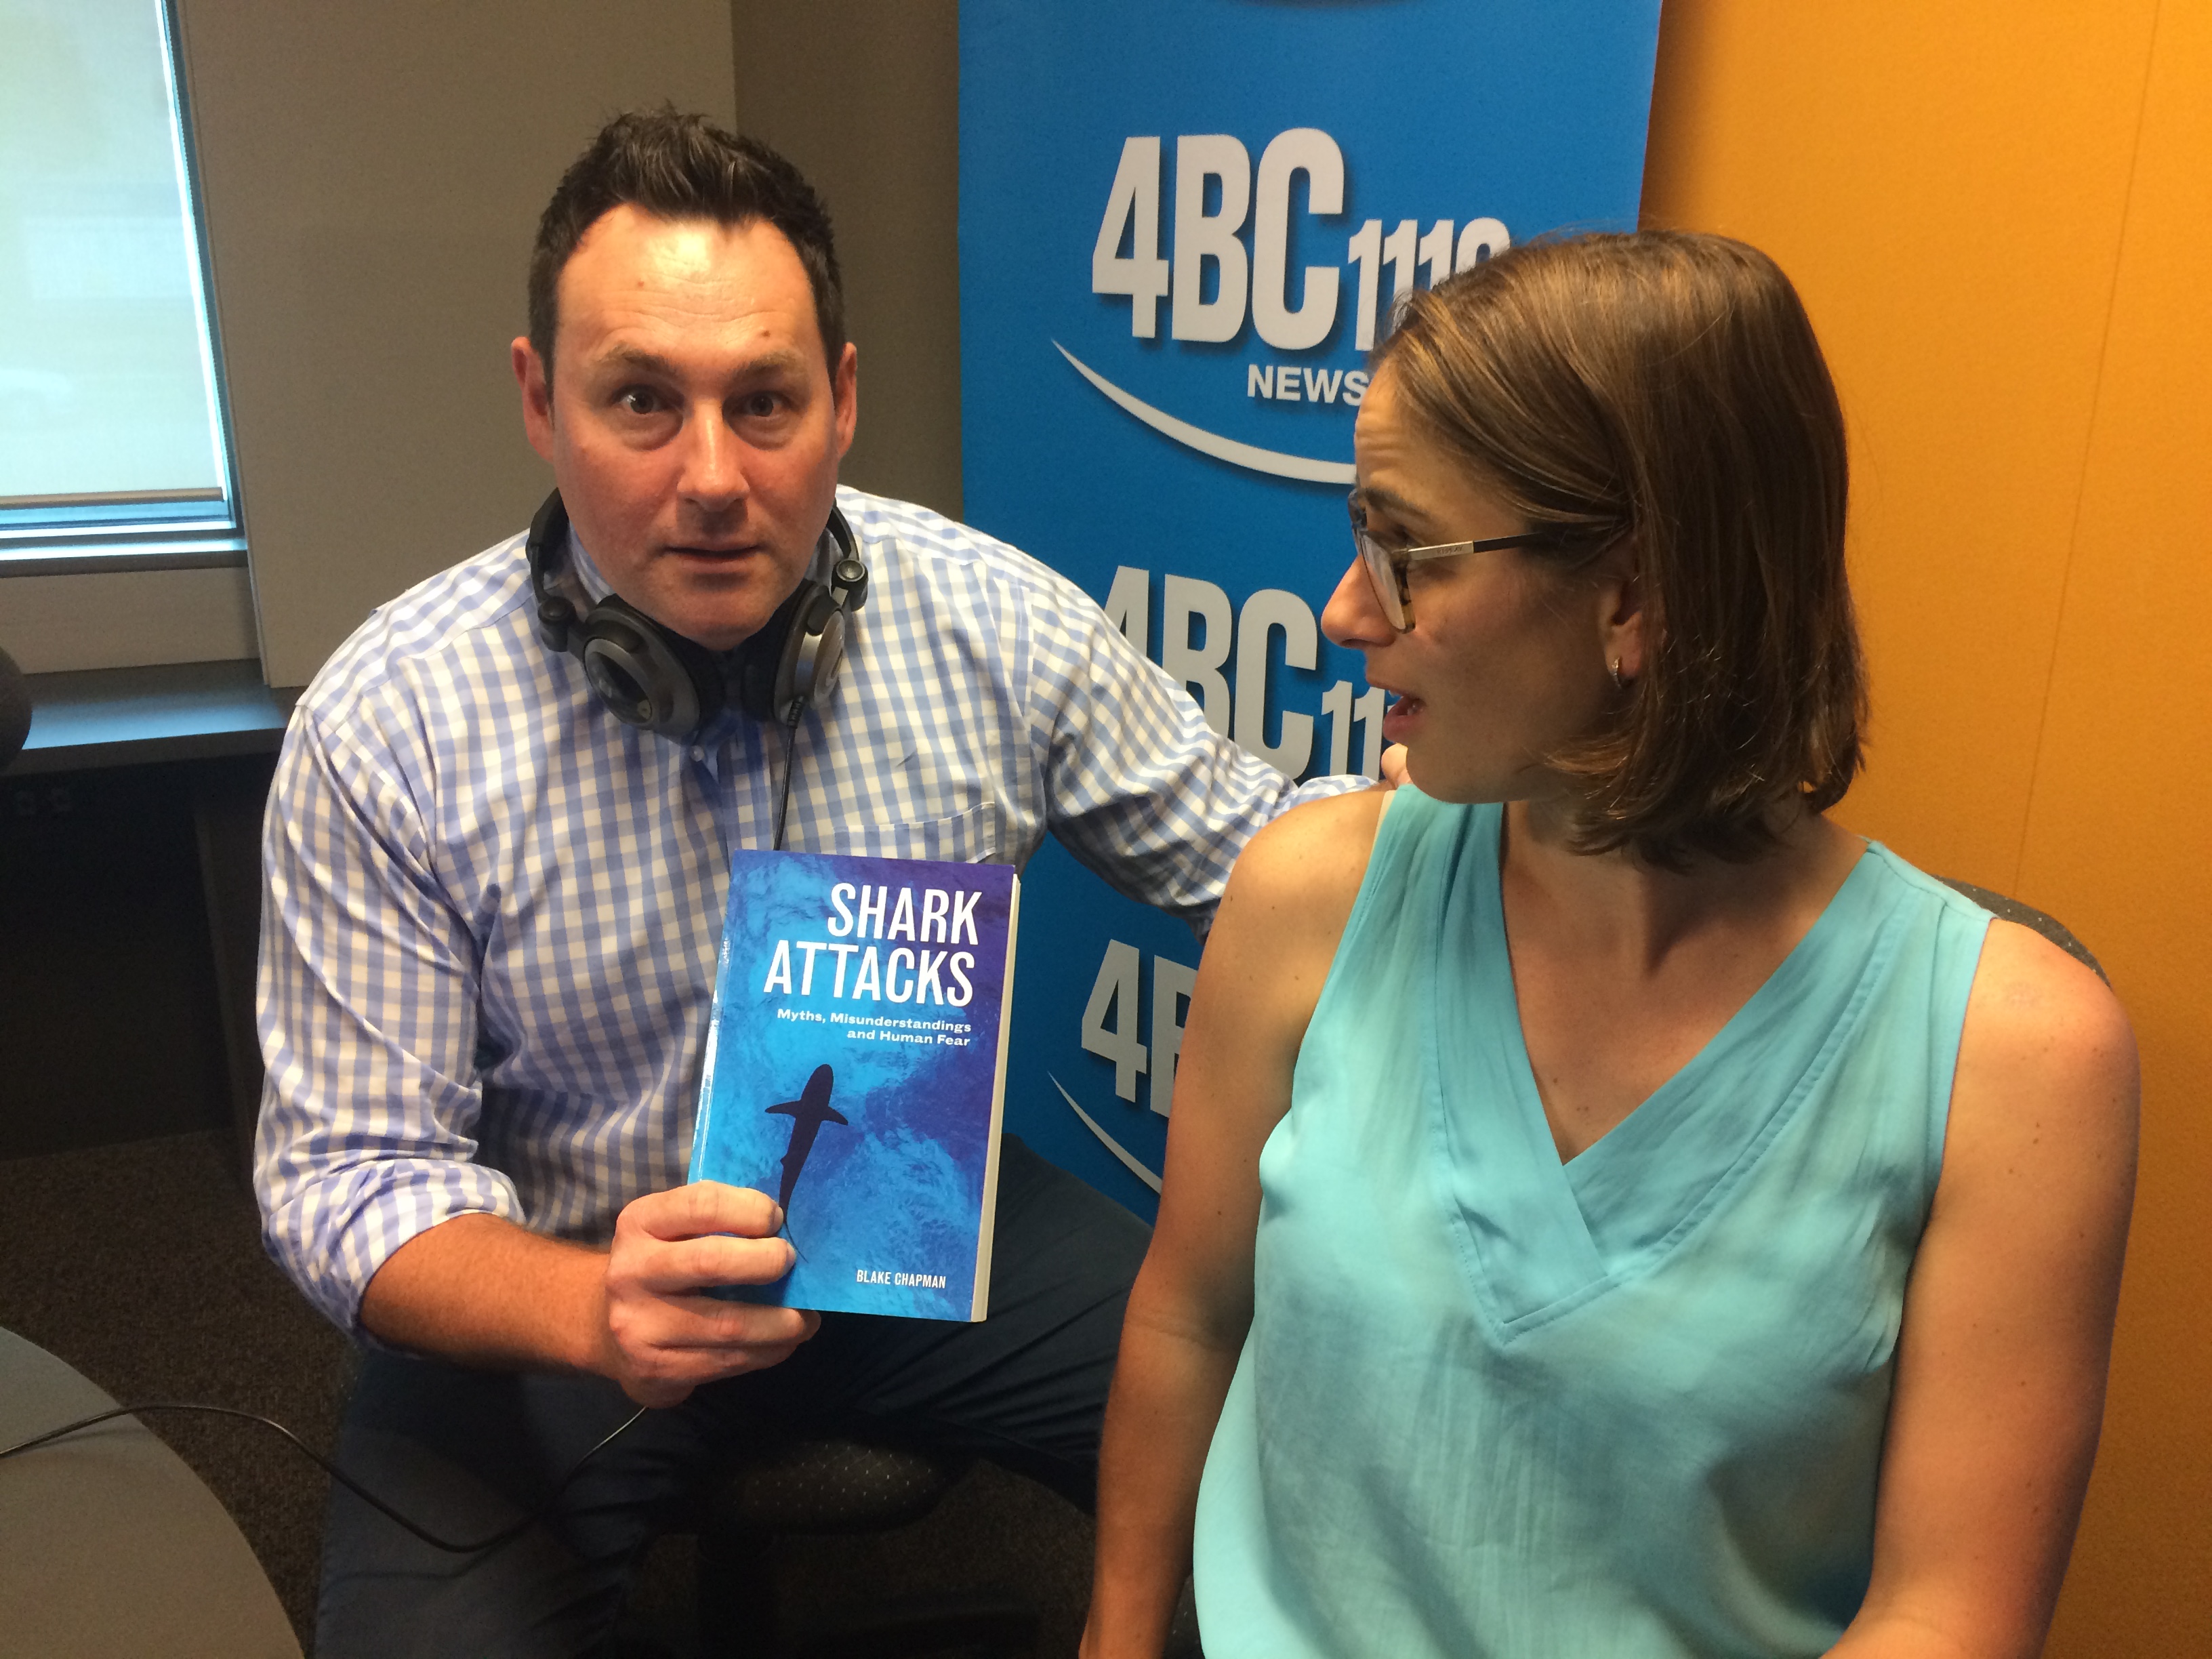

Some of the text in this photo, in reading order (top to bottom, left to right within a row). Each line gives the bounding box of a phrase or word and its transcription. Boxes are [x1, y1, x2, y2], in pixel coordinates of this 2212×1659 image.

[1092, 128, 1345, 350] 4BC
[1247, 364, 1368, 407] NEWS
[1321, 680, 1395, 781] 11
[827, 883, 982, 945] SHARK
[764, 940, 976, 1007] ATTACKS
[777, 1008, 971, 1033] Myths, Misunderstandings
[847, 1029, 970, 1046] and Human Fear
[857, 1269, 946, 1289] BLAKE CHAPMAN
